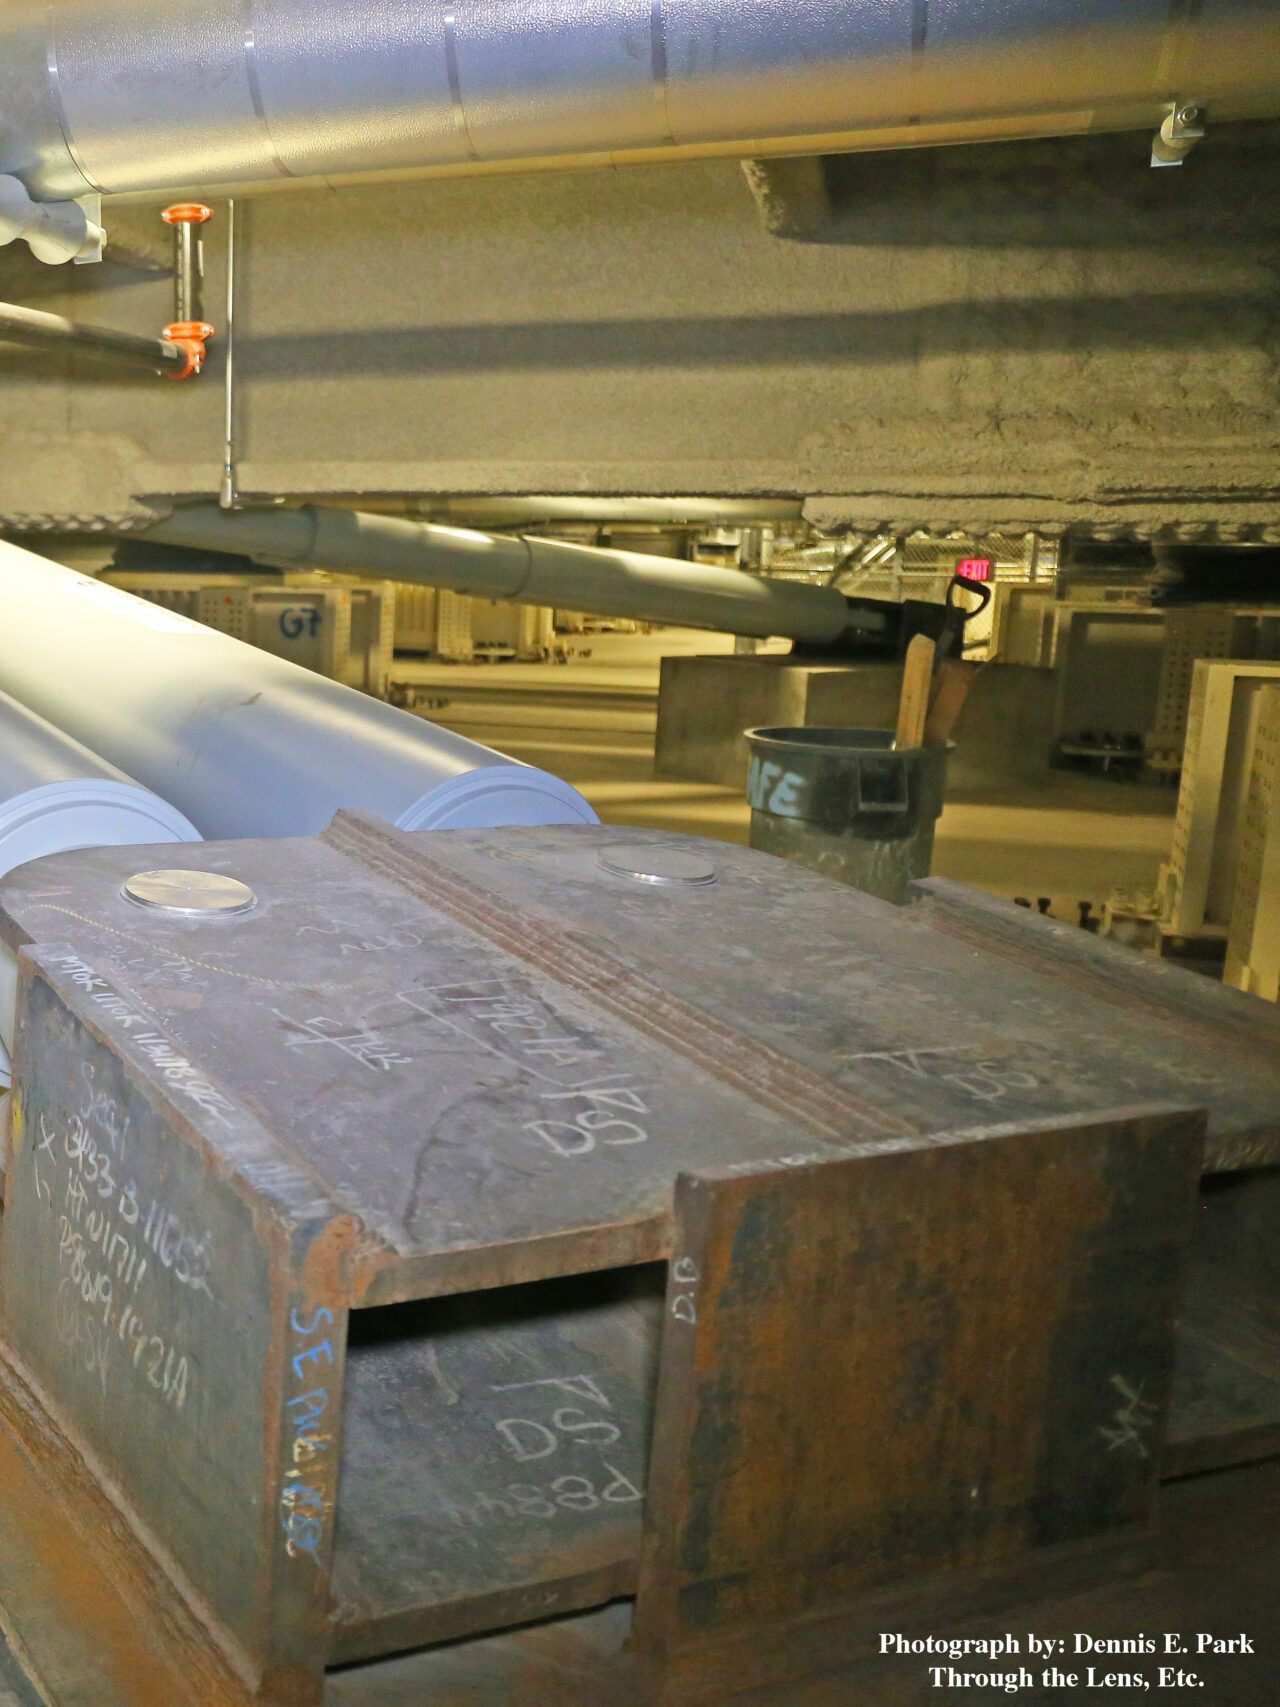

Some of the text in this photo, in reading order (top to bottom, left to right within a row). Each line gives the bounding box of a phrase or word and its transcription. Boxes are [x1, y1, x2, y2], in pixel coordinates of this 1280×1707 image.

[963, 560, 989, 580] EXIT
[279, 608, 322, 638] G7
[523, 1110, 648, 1158] DS
[495, 1408, 619, 1462] DS
